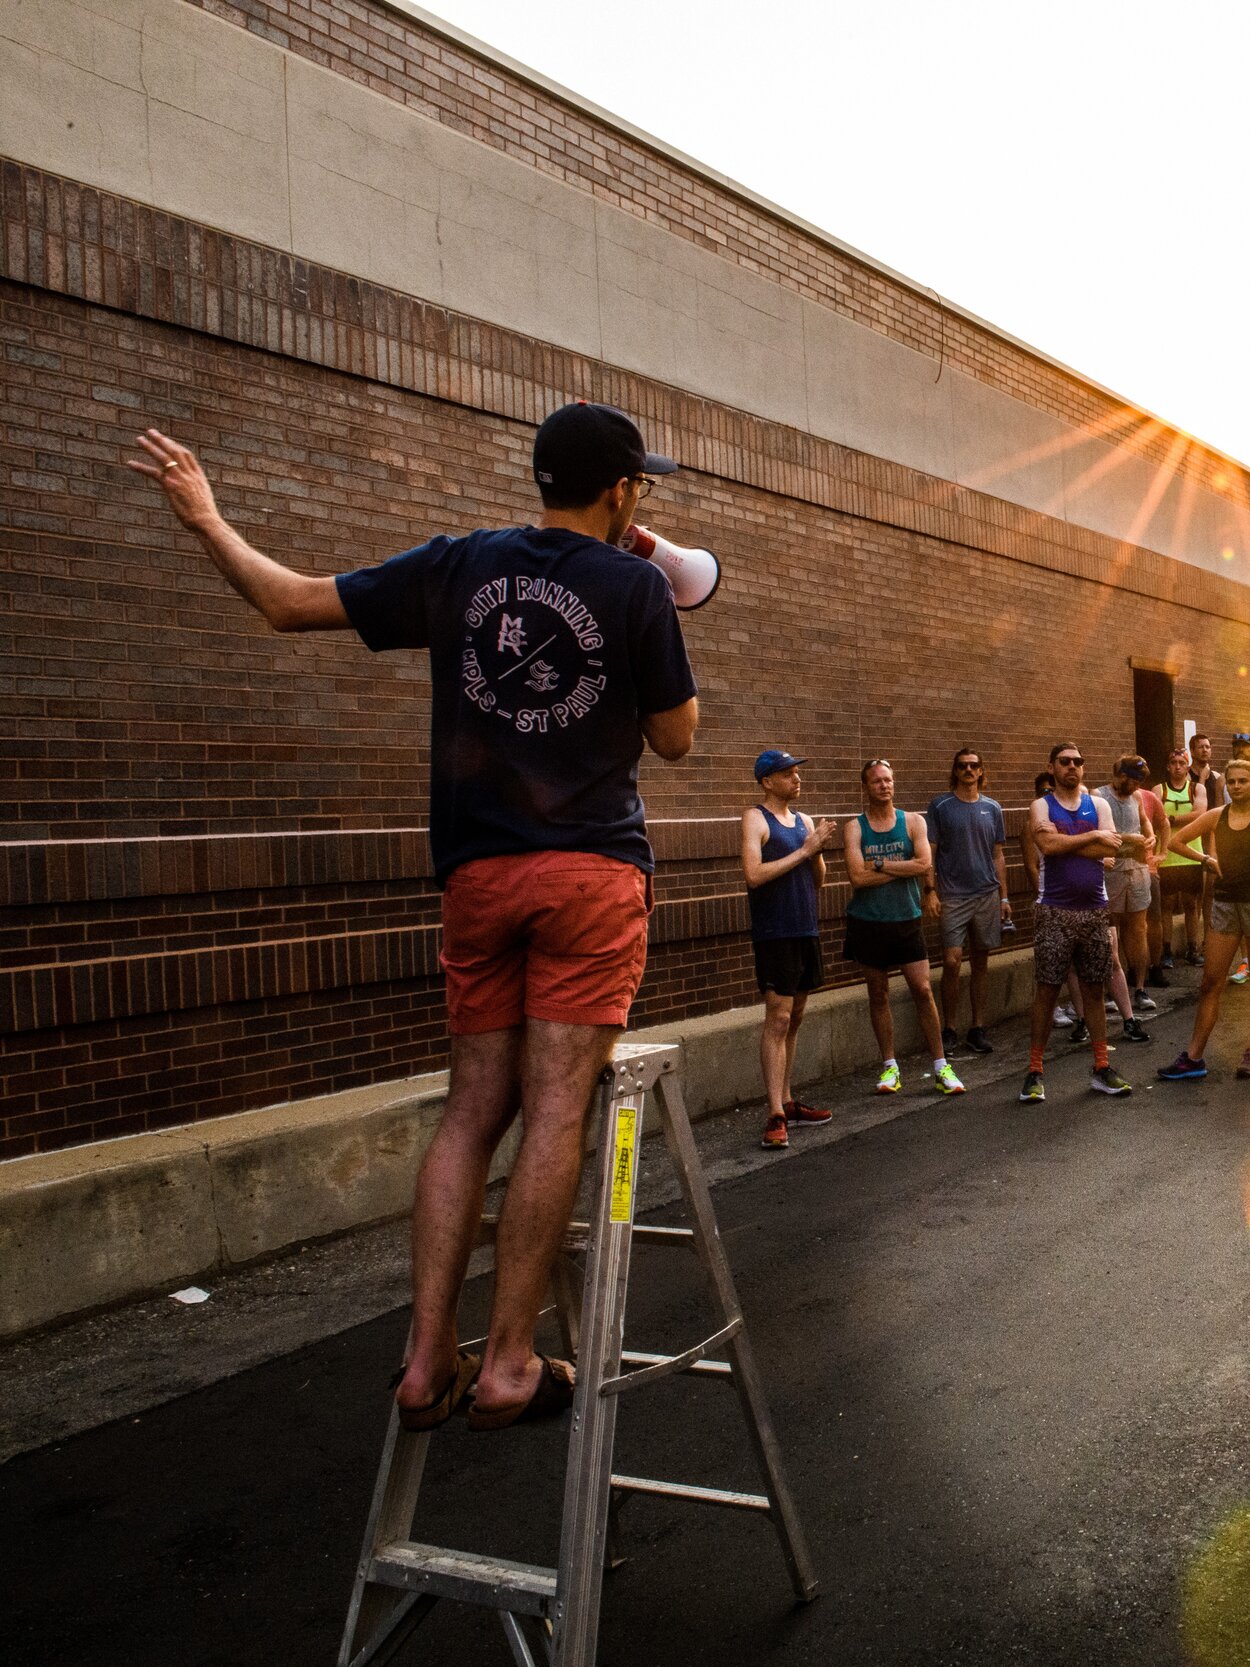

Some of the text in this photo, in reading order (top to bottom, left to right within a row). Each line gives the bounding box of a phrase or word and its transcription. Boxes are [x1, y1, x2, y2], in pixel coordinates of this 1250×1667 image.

[465, 576, 603, 651] CITY RUNNING
[462, 649, 607, 733] MPLS ST PAUL
[886, 841, 904, 853] CITY
